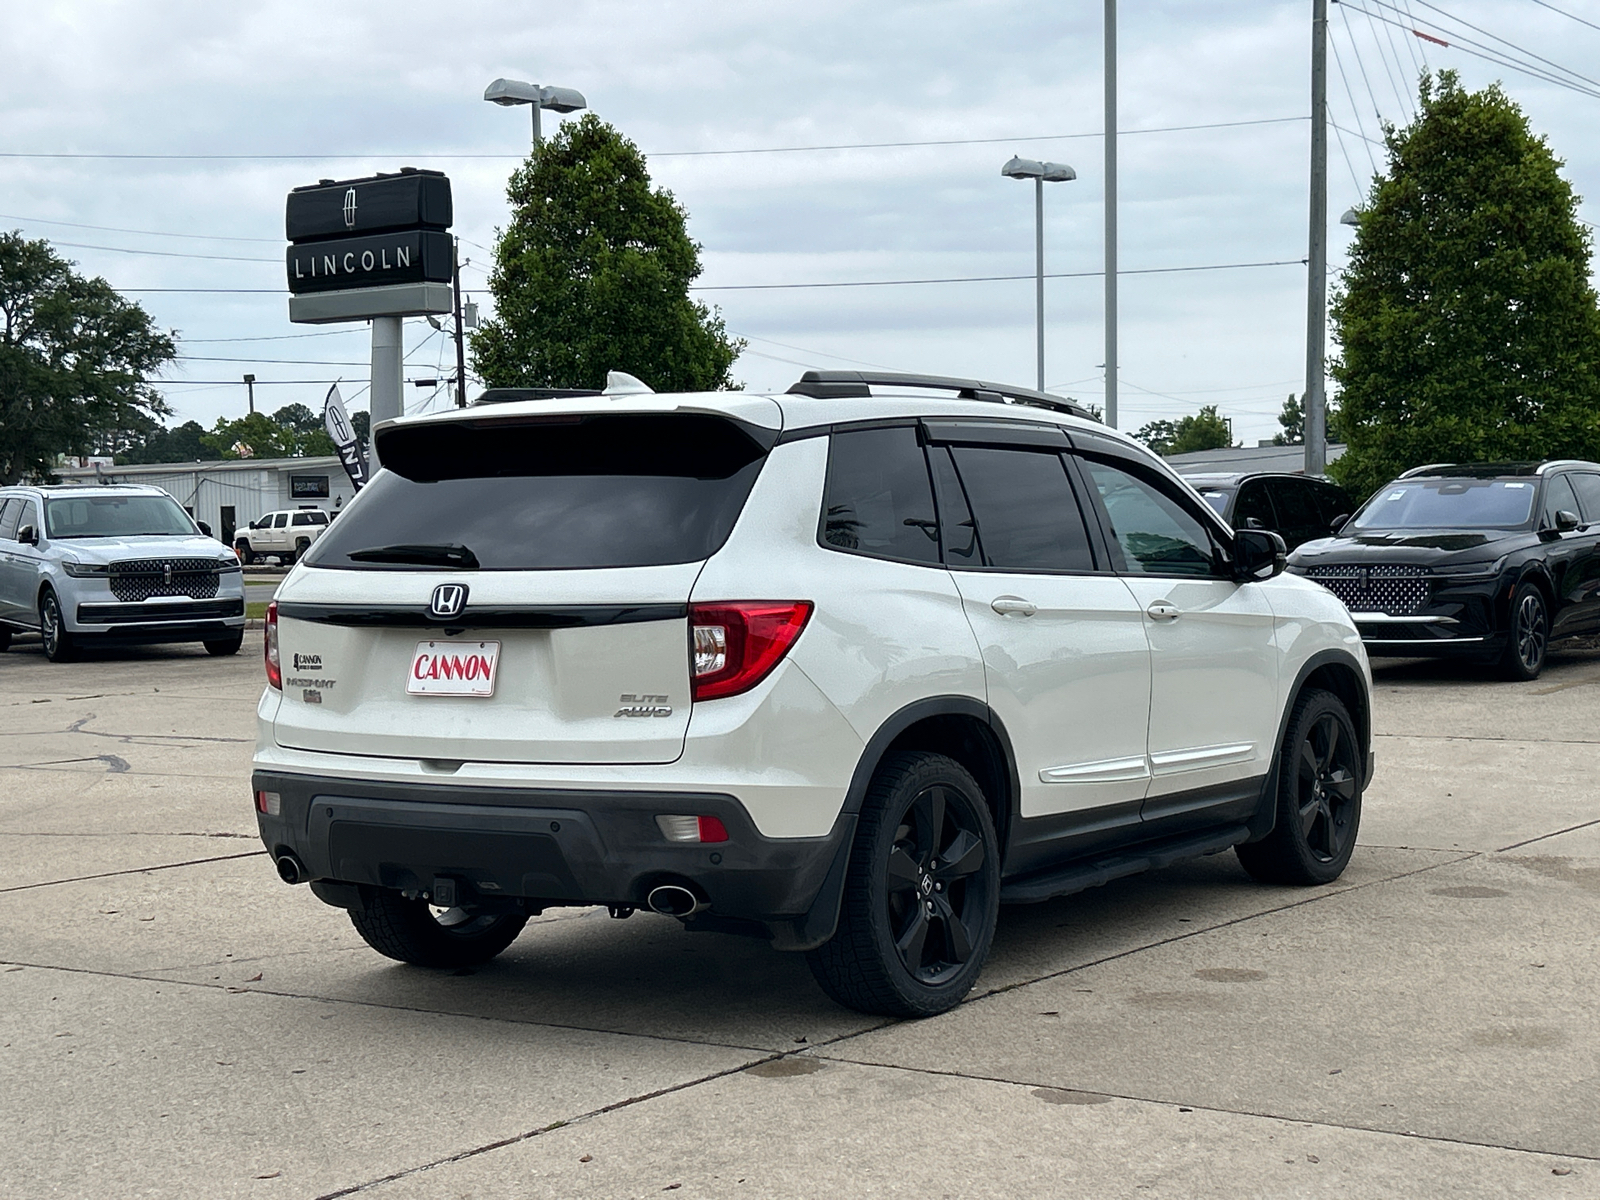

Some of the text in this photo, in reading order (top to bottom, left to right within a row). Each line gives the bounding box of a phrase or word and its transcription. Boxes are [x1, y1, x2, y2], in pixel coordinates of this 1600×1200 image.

[295, 246, 410, 278] LINCOLN
[299, 654, 322, 664] CANNON
[414, 654, 494, 681] CANNON
[620, 694, 668, 703] ELITE
[613, 706, 673, 718] AWD
